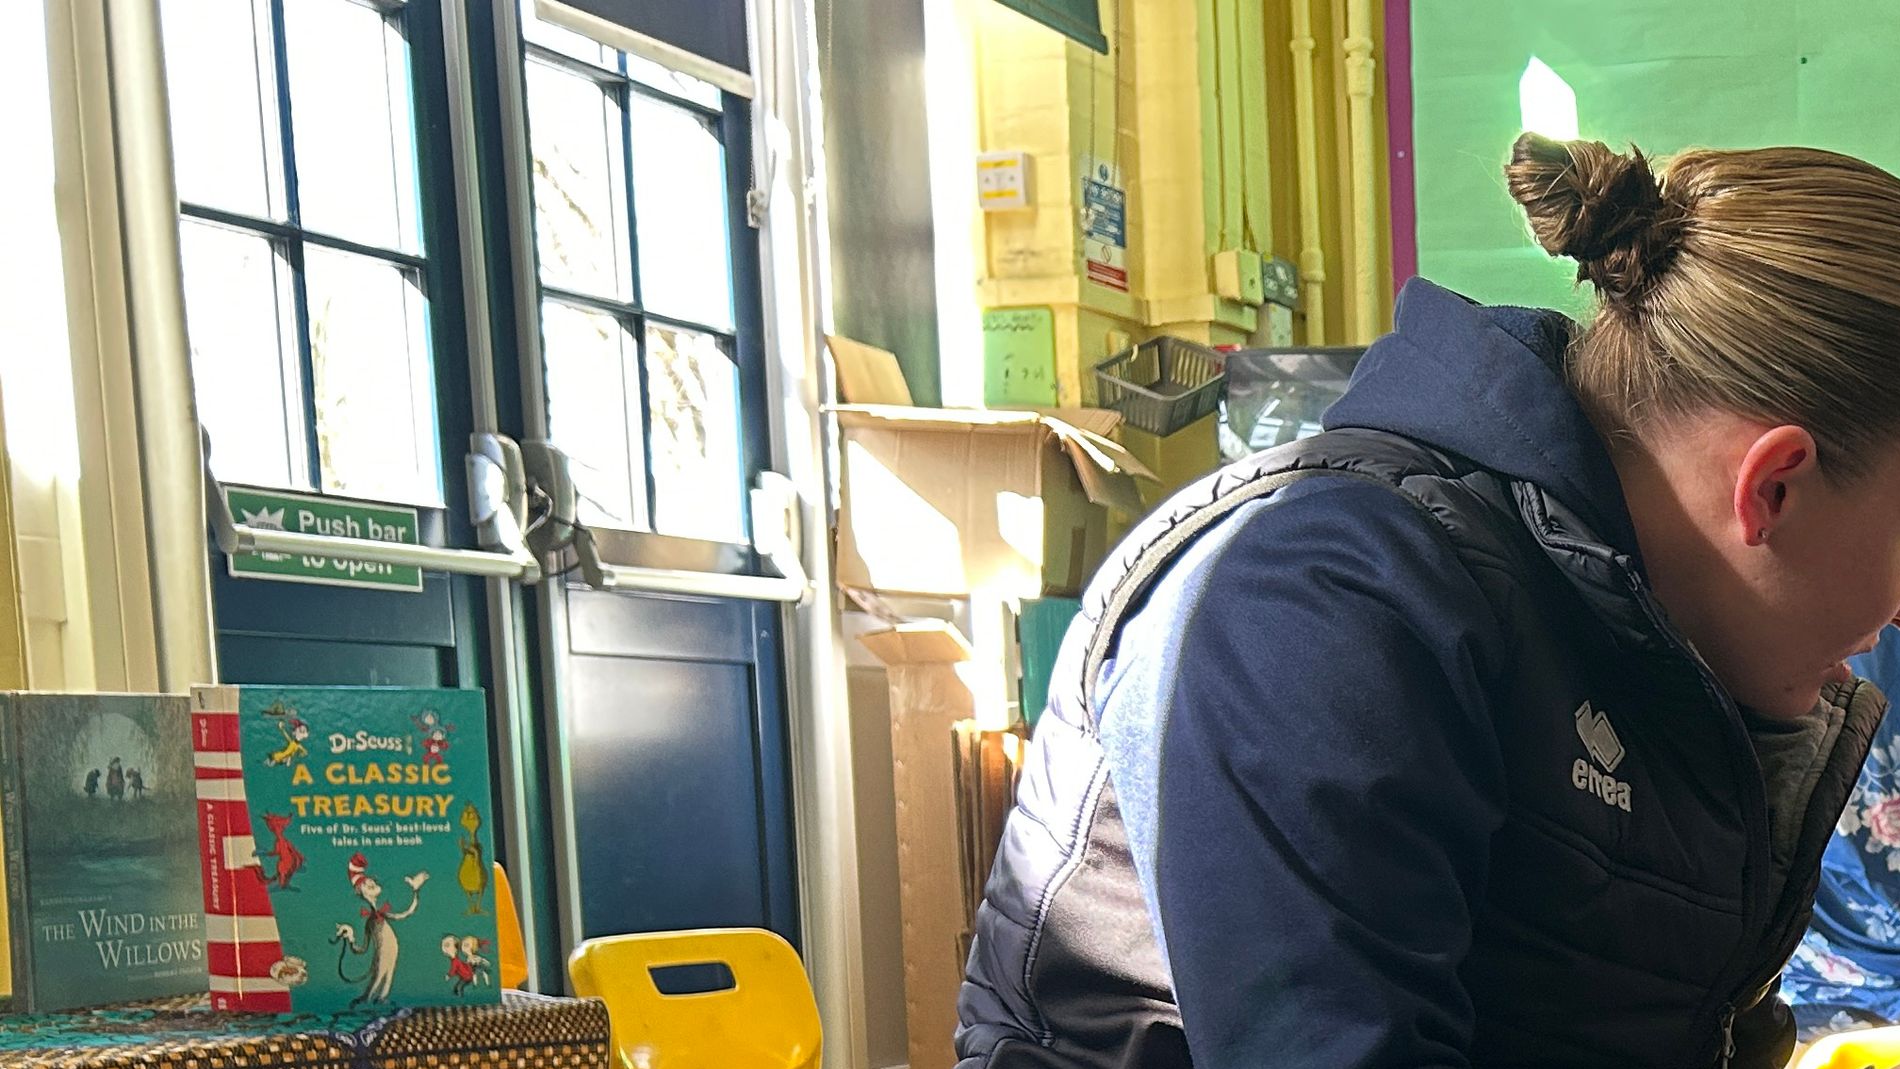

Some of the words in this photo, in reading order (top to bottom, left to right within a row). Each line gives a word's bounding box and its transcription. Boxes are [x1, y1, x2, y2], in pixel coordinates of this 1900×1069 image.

[299, 510, 360, 538] Push
[368, 517, 406, 541] bar
[333, 557, 392, 577] open
[292, 763, 314, 785] A
[325, 762, 452, 785] CLASSIC
[291, 794, 453, 817] TREASURY
[301, 822, 323, 834] Five
[326, 822, 338, 834] of
[342, 823, 358, 834] Dr.
[332, 836, 358, 847] tales
[362, 836, 371, 846] in
[375, 837, 393, 846] one
[397, 835, 422, 846] book
[42, 924, 76, 942] THE
[78, 908, 145, 939] WIND
[150, 917, 165, 932] IN
[168, 913, 198, 931] THE
[96, 939, 201, 970] WILLOWS
